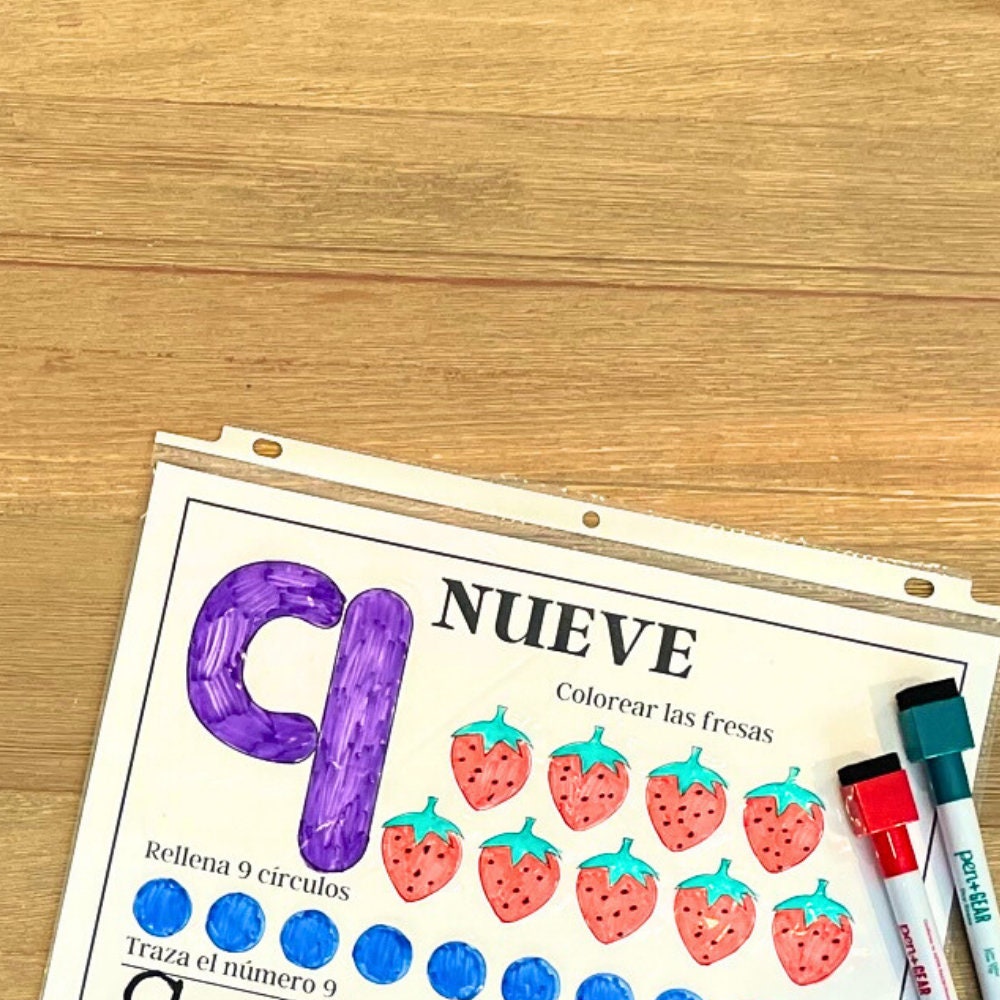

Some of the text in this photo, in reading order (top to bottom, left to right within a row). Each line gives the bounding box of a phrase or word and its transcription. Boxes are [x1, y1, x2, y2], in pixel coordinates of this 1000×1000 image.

[431, 577, 698, 679] NUEVE
[187, 560, 414, 872] 9
[556, 682, 775, 745] Colorear las fresas
[145, 840, 352, 902] Rellena 9 círculos
[126, 936, 338, 998] Traza el número 9
